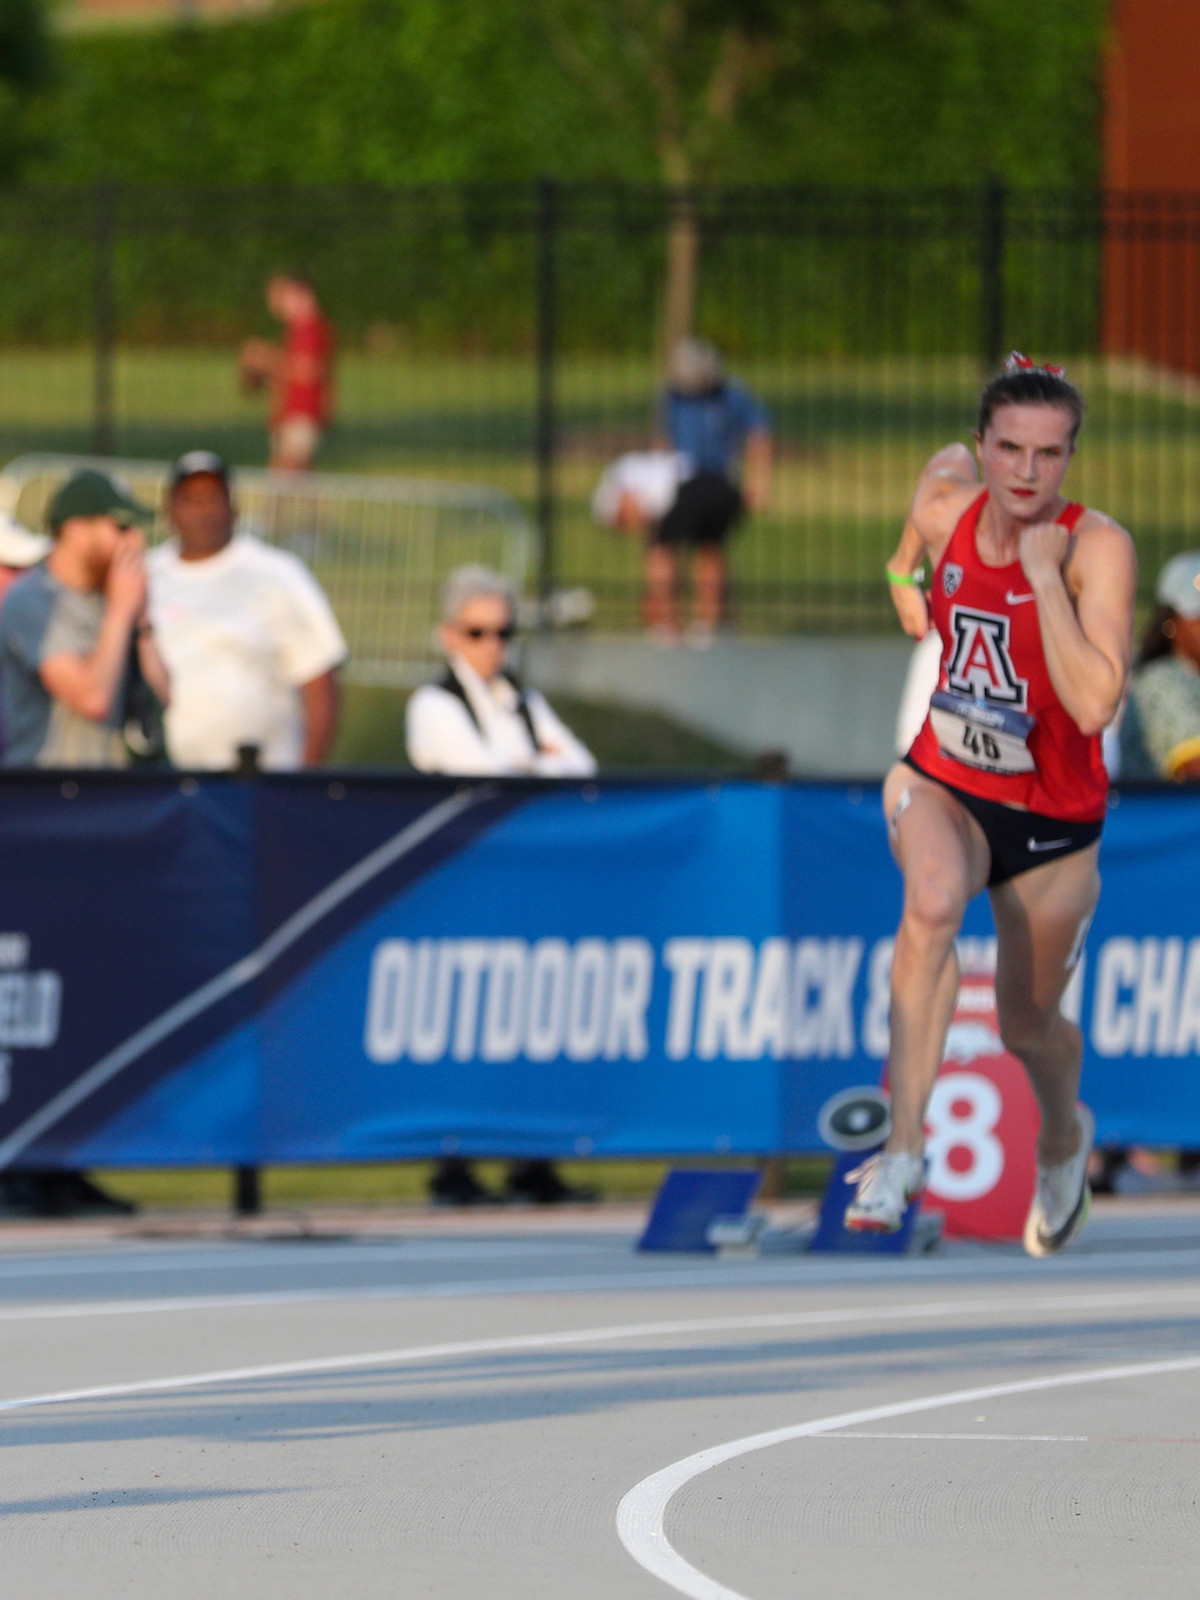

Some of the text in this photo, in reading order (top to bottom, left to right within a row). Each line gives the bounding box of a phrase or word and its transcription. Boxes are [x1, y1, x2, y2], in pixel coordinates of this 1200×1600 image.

[949, 604, 1028, 711] A
[363, 937, 655, 1064] OUTDOOR
[662, 936, 864, 1062] TRACK
[924, 1071, 1005, 1201] 8
